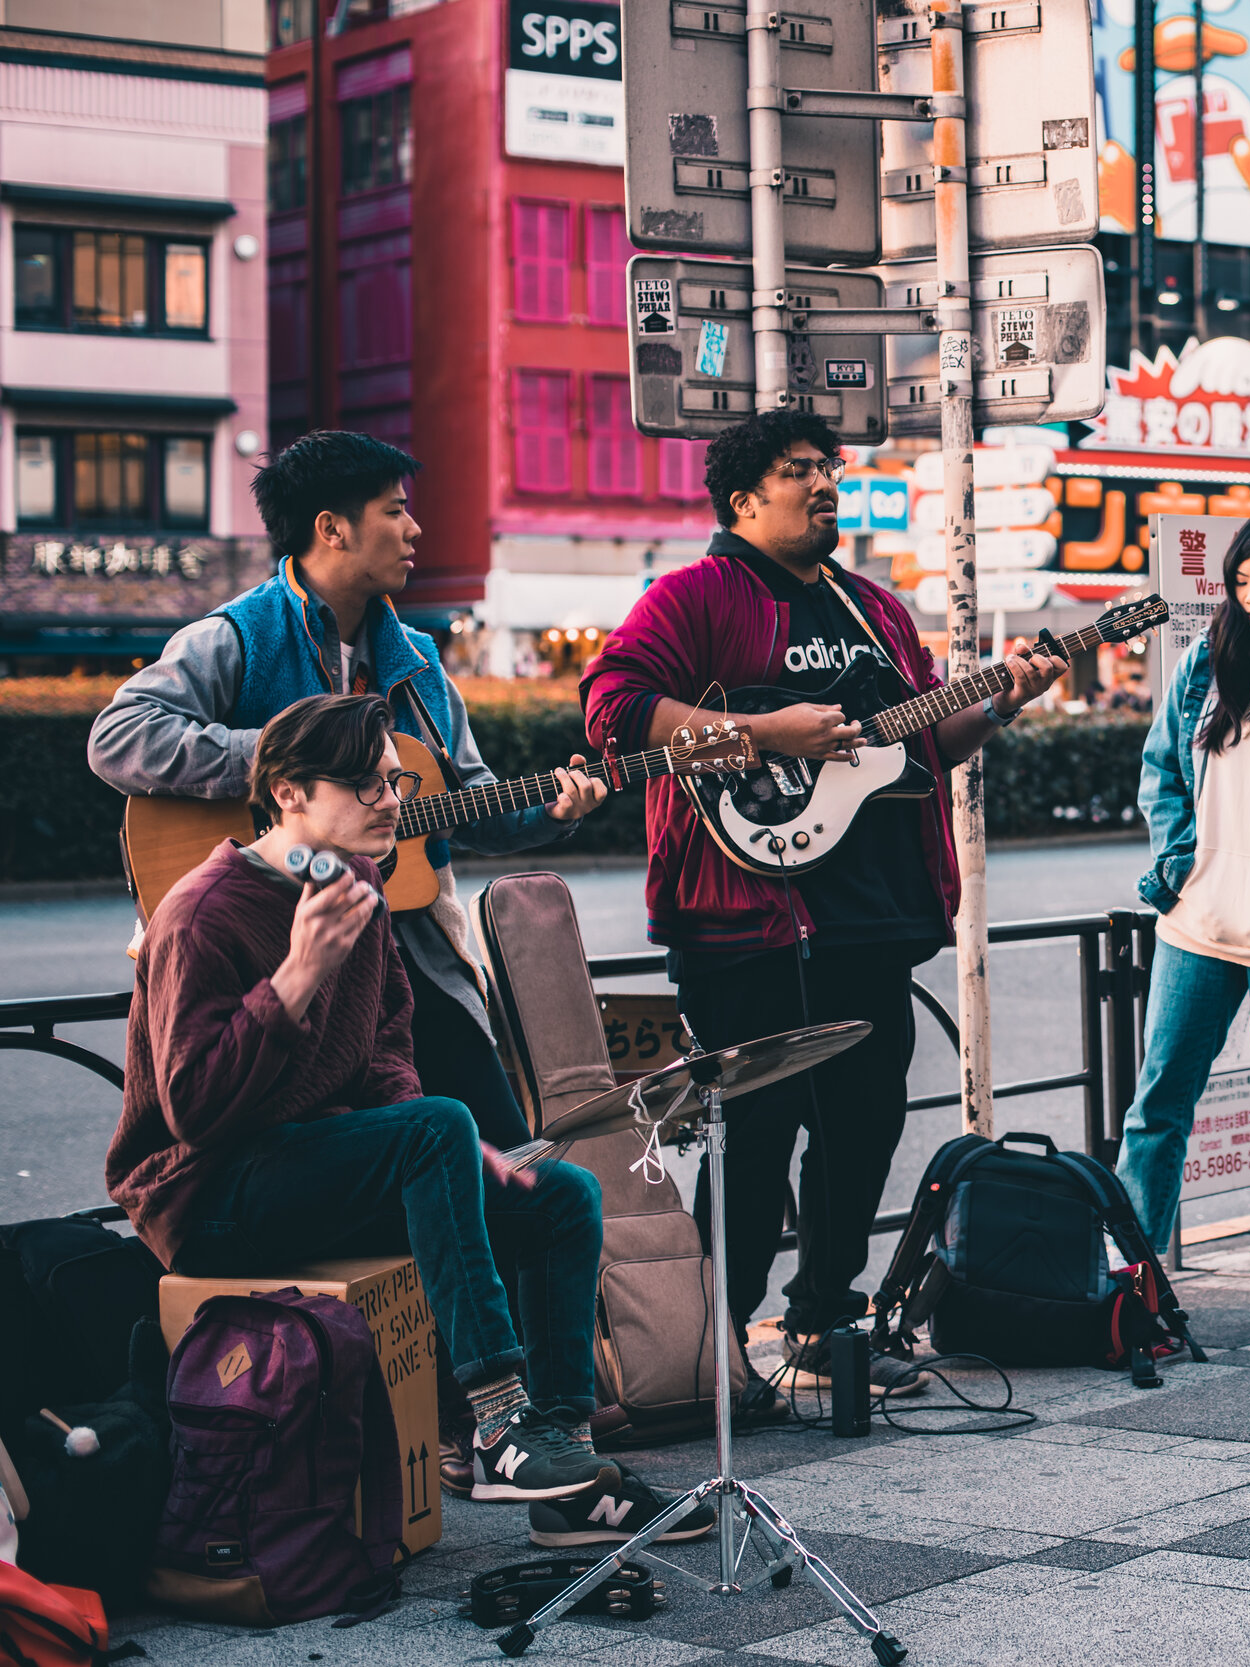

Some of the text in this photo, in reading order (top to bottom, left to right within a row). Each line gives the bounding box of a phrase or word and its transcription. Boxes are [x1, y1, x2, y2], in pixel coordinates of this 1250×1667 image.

[521, 12, 618, 66] SPPS
[636, 280, 669, 291] TETO
[638, 302, 671, 313] PHEAR
[1000, 309, 1034, 321] TETO
[1001, 331, 1034, 342] PHEAR
[494, 1443, 530, 1481] N
[587, 1494, 634, 1528] N
